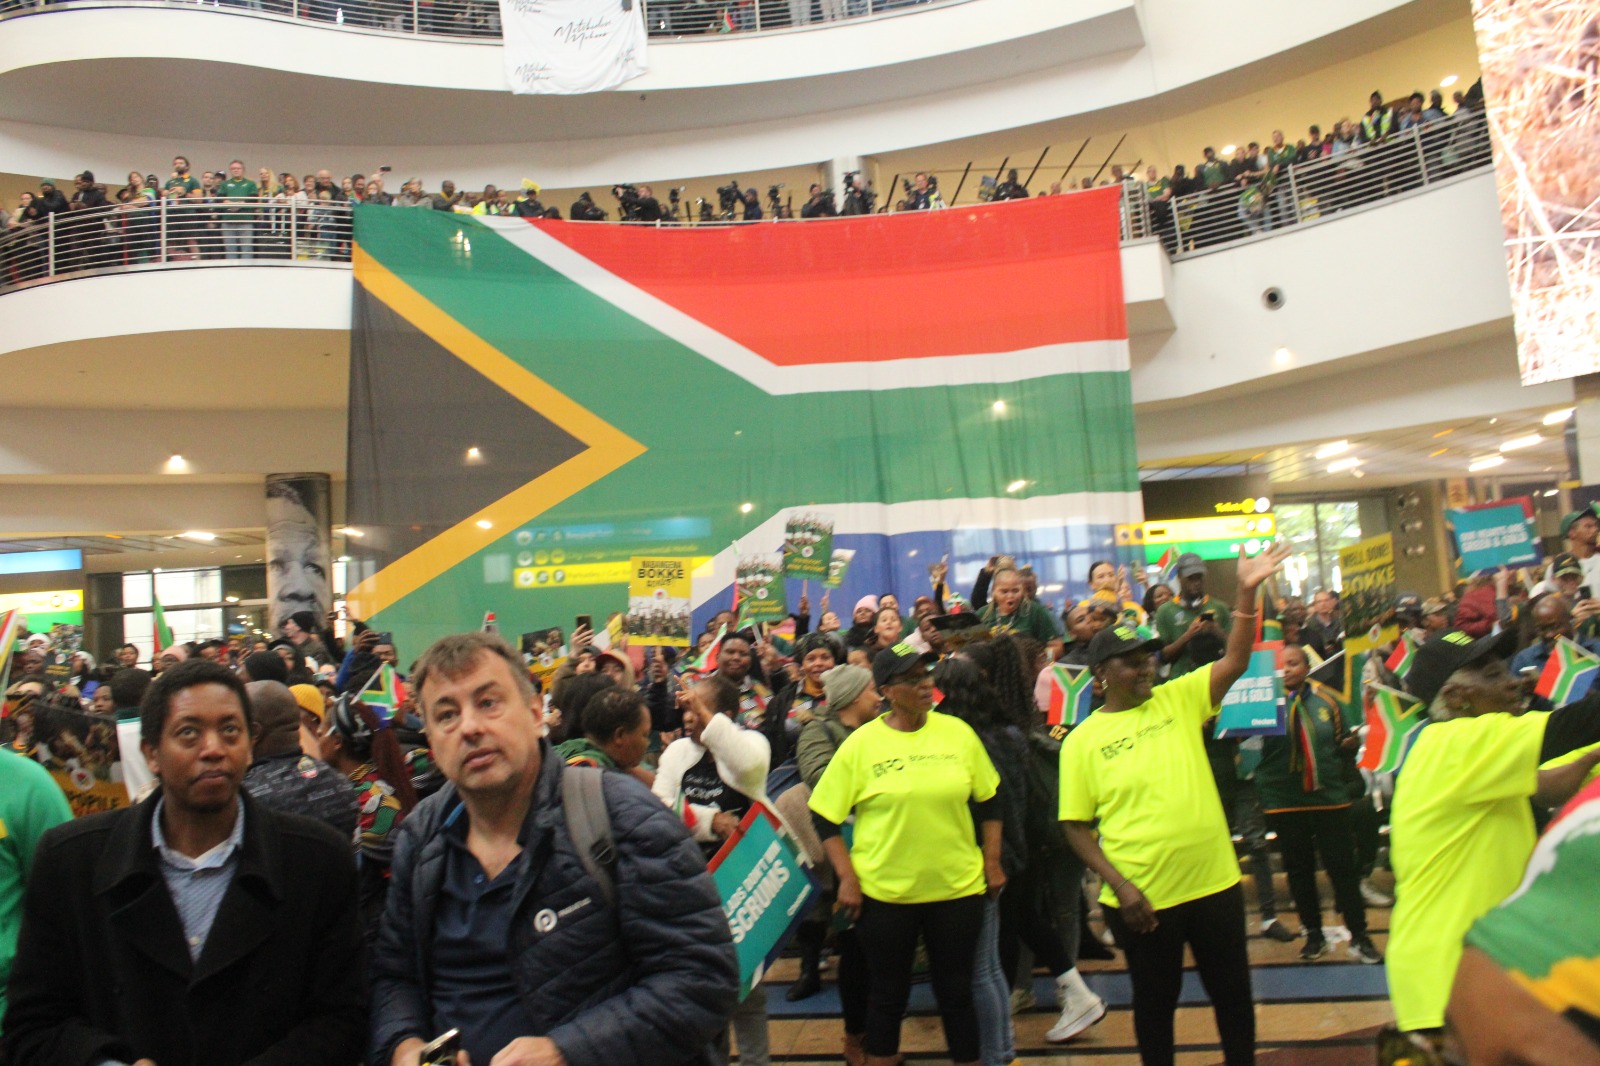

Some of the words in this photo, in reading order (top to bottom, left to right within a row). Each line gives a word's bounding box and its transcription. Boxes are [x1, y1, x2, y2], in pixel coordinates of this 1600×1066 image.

[637, 568, 684, 579] BOKKE
[1249, 687, 1274, 703] GOLD
[727, 858, 791, 944] SCRUMS
